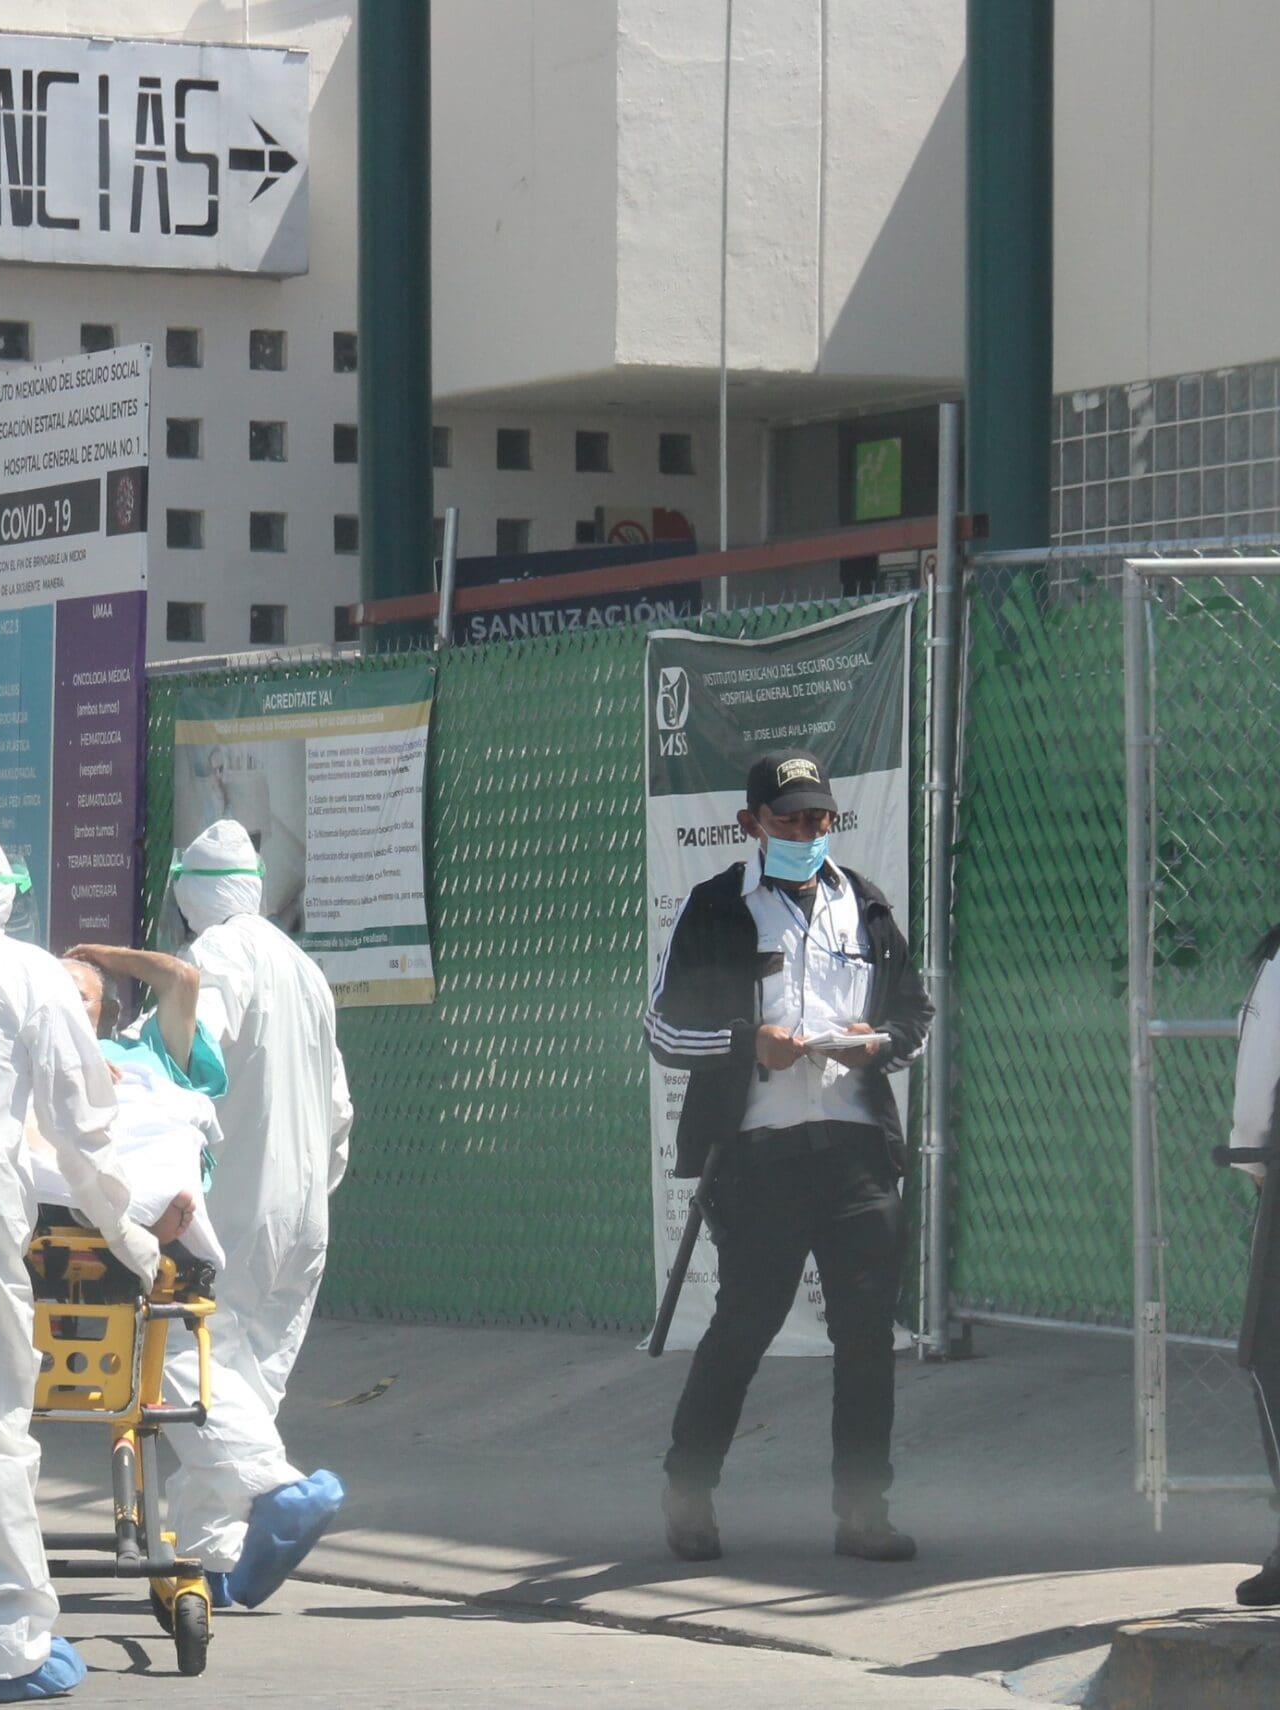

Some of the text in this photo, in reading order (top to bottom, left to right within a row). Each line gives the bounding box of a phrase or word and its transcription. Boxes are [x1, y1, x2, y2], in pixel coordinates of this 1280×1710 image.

[16, 376, 57, 400] MEXICANO
[59, 373, 73, 391] DEL
[76, 366, 109, 389] SEGURO
[111, 359, 140, 381] SOCIAL
[34, 412, 66, 435] ESTATAL
[67, 398, 138, 428] AGUASCALIENTES
[4, 454, 41, 476] HOSPITAL
[43, 448, 80, 469] GENERAL
[82, 445, 92, 463] DE
[94, 439, 117, 462] ZONA
[92, 603, 113, 619] UMAA
[471, 597, 676, 640] SANITIZACIÓN
[704, 653, 873, 687] INSTITUTO MEXICANO DEL SEGURO SOCIAL
[318, 688, 333, 706] YA!
[720, 690, 755, 706] HOSPITAL
[756, 686, 793, 702] GENERAL
[794, 684, 805, 698] DE
[806, 680, 832, 696] ZONA
[754, 727, 771, 741] JOSE
[772, 725, 787, 739] LUIS
[788, 723, 808, 738] AVILA
[808, 720, 836, 736] PARDO
[677, 825, 748, 847] PACIENTES
